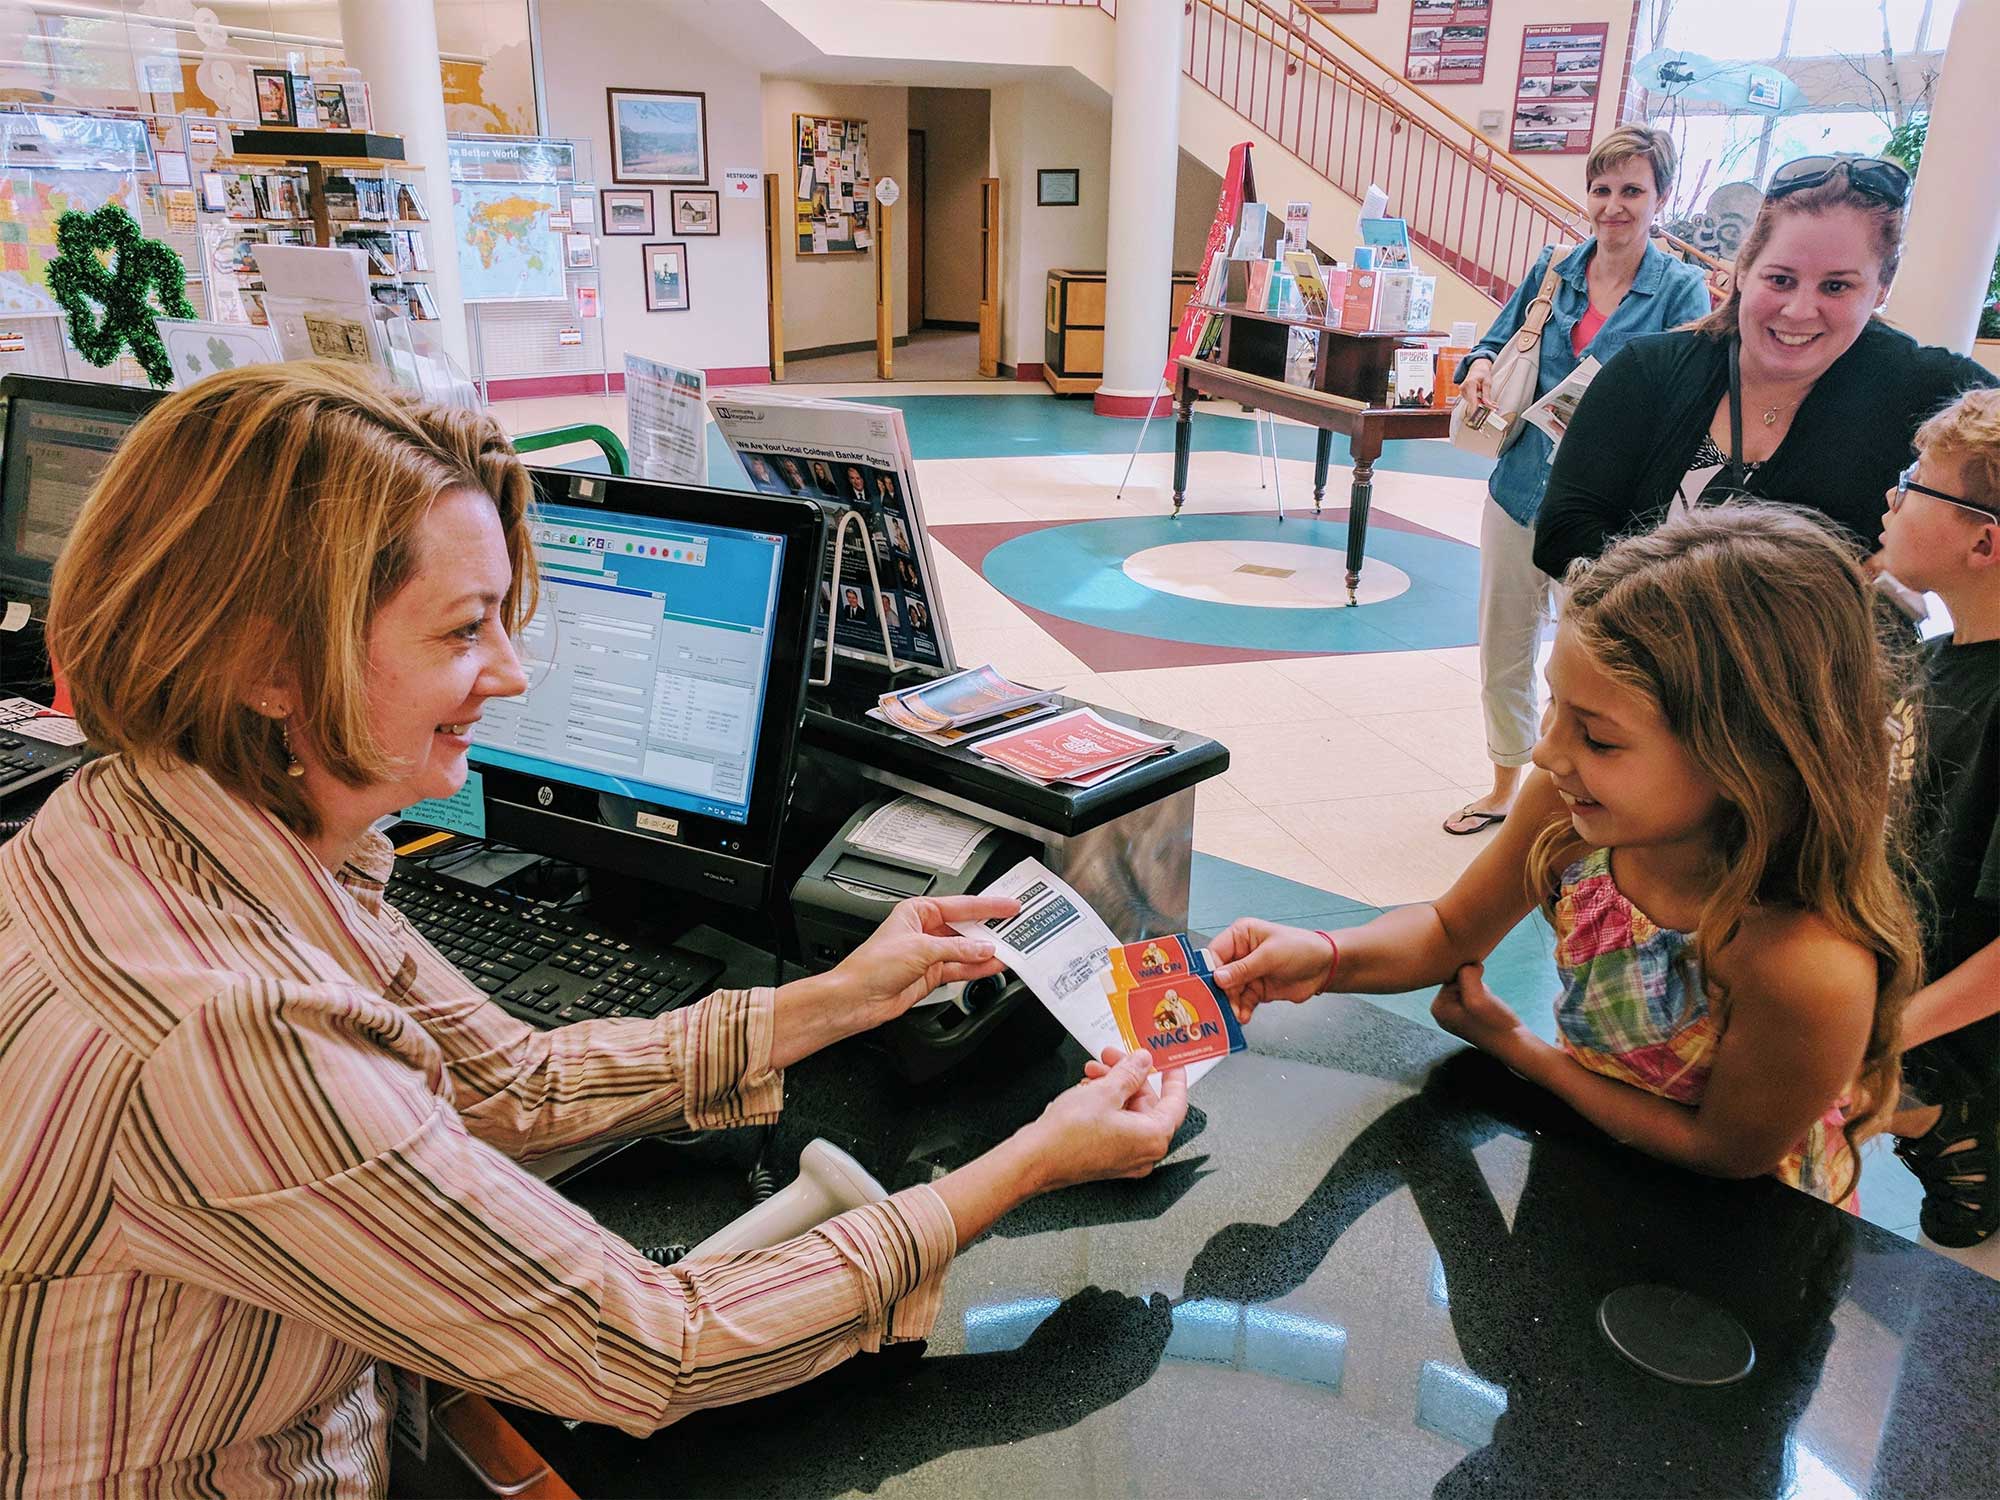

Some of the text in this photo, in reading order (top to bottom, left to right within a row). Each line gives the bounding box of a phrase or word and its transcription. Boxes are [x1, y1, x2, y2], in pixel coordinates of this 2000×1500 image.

[461, 148, 490, 157] Better
[492, 149, 519, 158] World
[726, 172, 758, 180] RESTROOMS
[736, 441, 891, 467] We Are Your Local Coldwell Banker Agents
[539, 787, 552, 806] hp
[1027, 884, 1046, 897] YOUR
[1003, 921, 1031, 943] PETERS
[1031, 896, 1066, 923] TOWNSHIP
[1014, 923, 1042, 946] PUBLIC
[1041, 905, 1070, 927] LIBRARY
